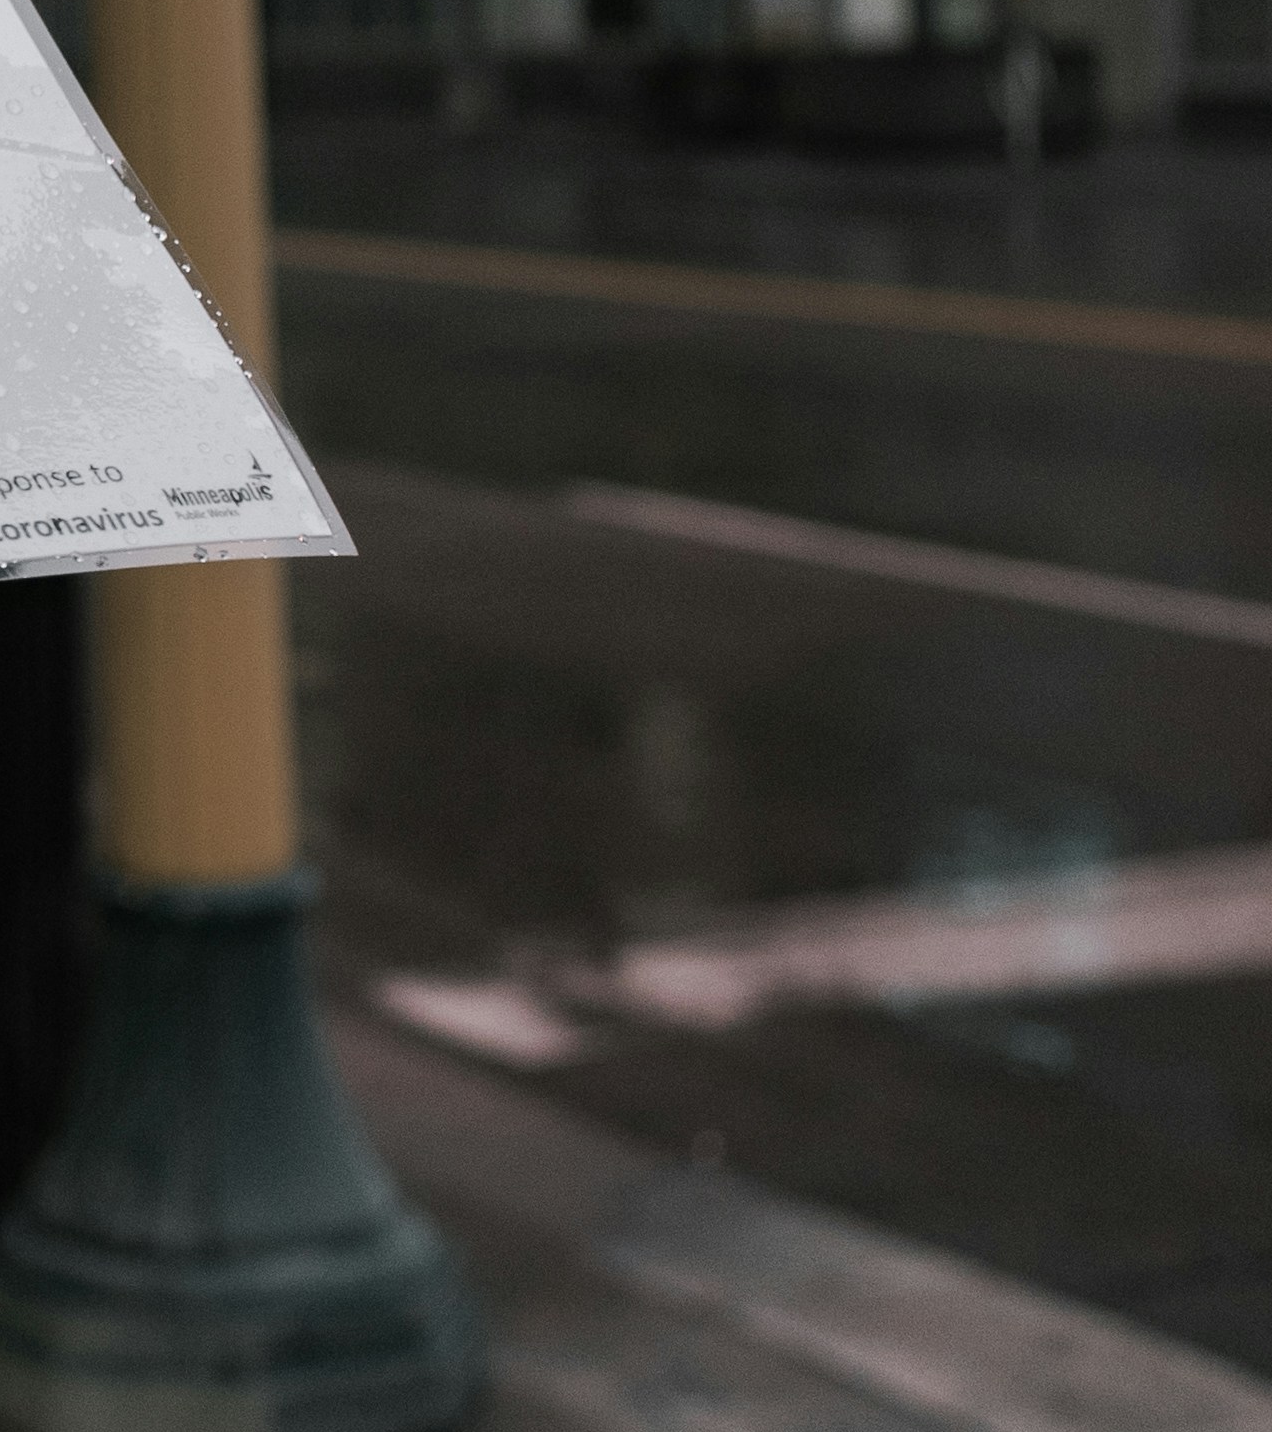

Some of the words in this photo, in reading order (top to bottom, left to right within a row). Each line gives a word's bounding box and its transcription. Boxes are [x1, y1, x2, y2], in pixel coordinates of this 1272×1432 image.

[90, 462, 124, 484] to
[161, 482, 274, 507] Minneapolis
[175, 508, 205, 520] Public
[207, 508, 240, 518] Works
